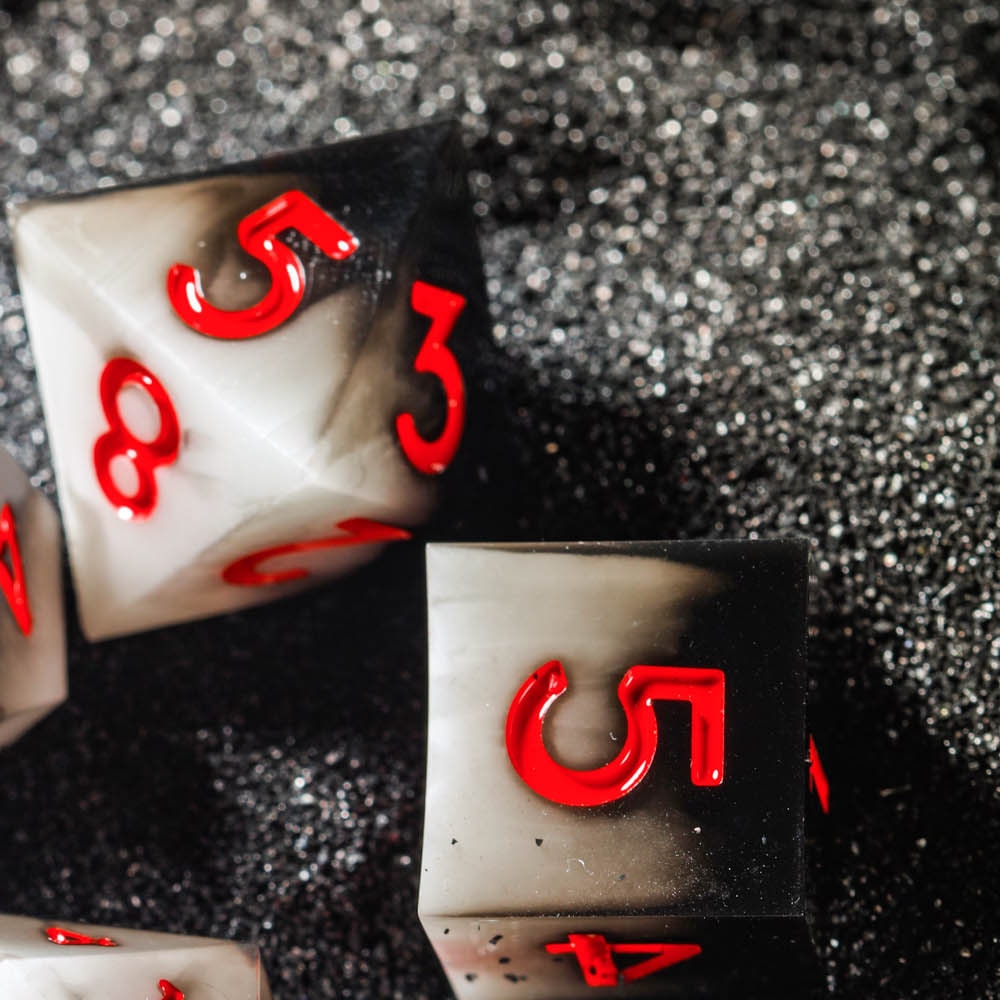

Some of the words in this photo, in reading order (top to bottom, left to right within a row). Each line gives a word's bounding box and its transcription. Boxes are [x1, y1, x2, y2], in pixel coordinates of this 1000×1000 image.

[165, 189, 358, 340] 5
[91, 356, 183, 522] 8
[395, 280, 467, 475] 3
[504, 659, 726, 808] 5
[545, 933, 703, 988] 4
